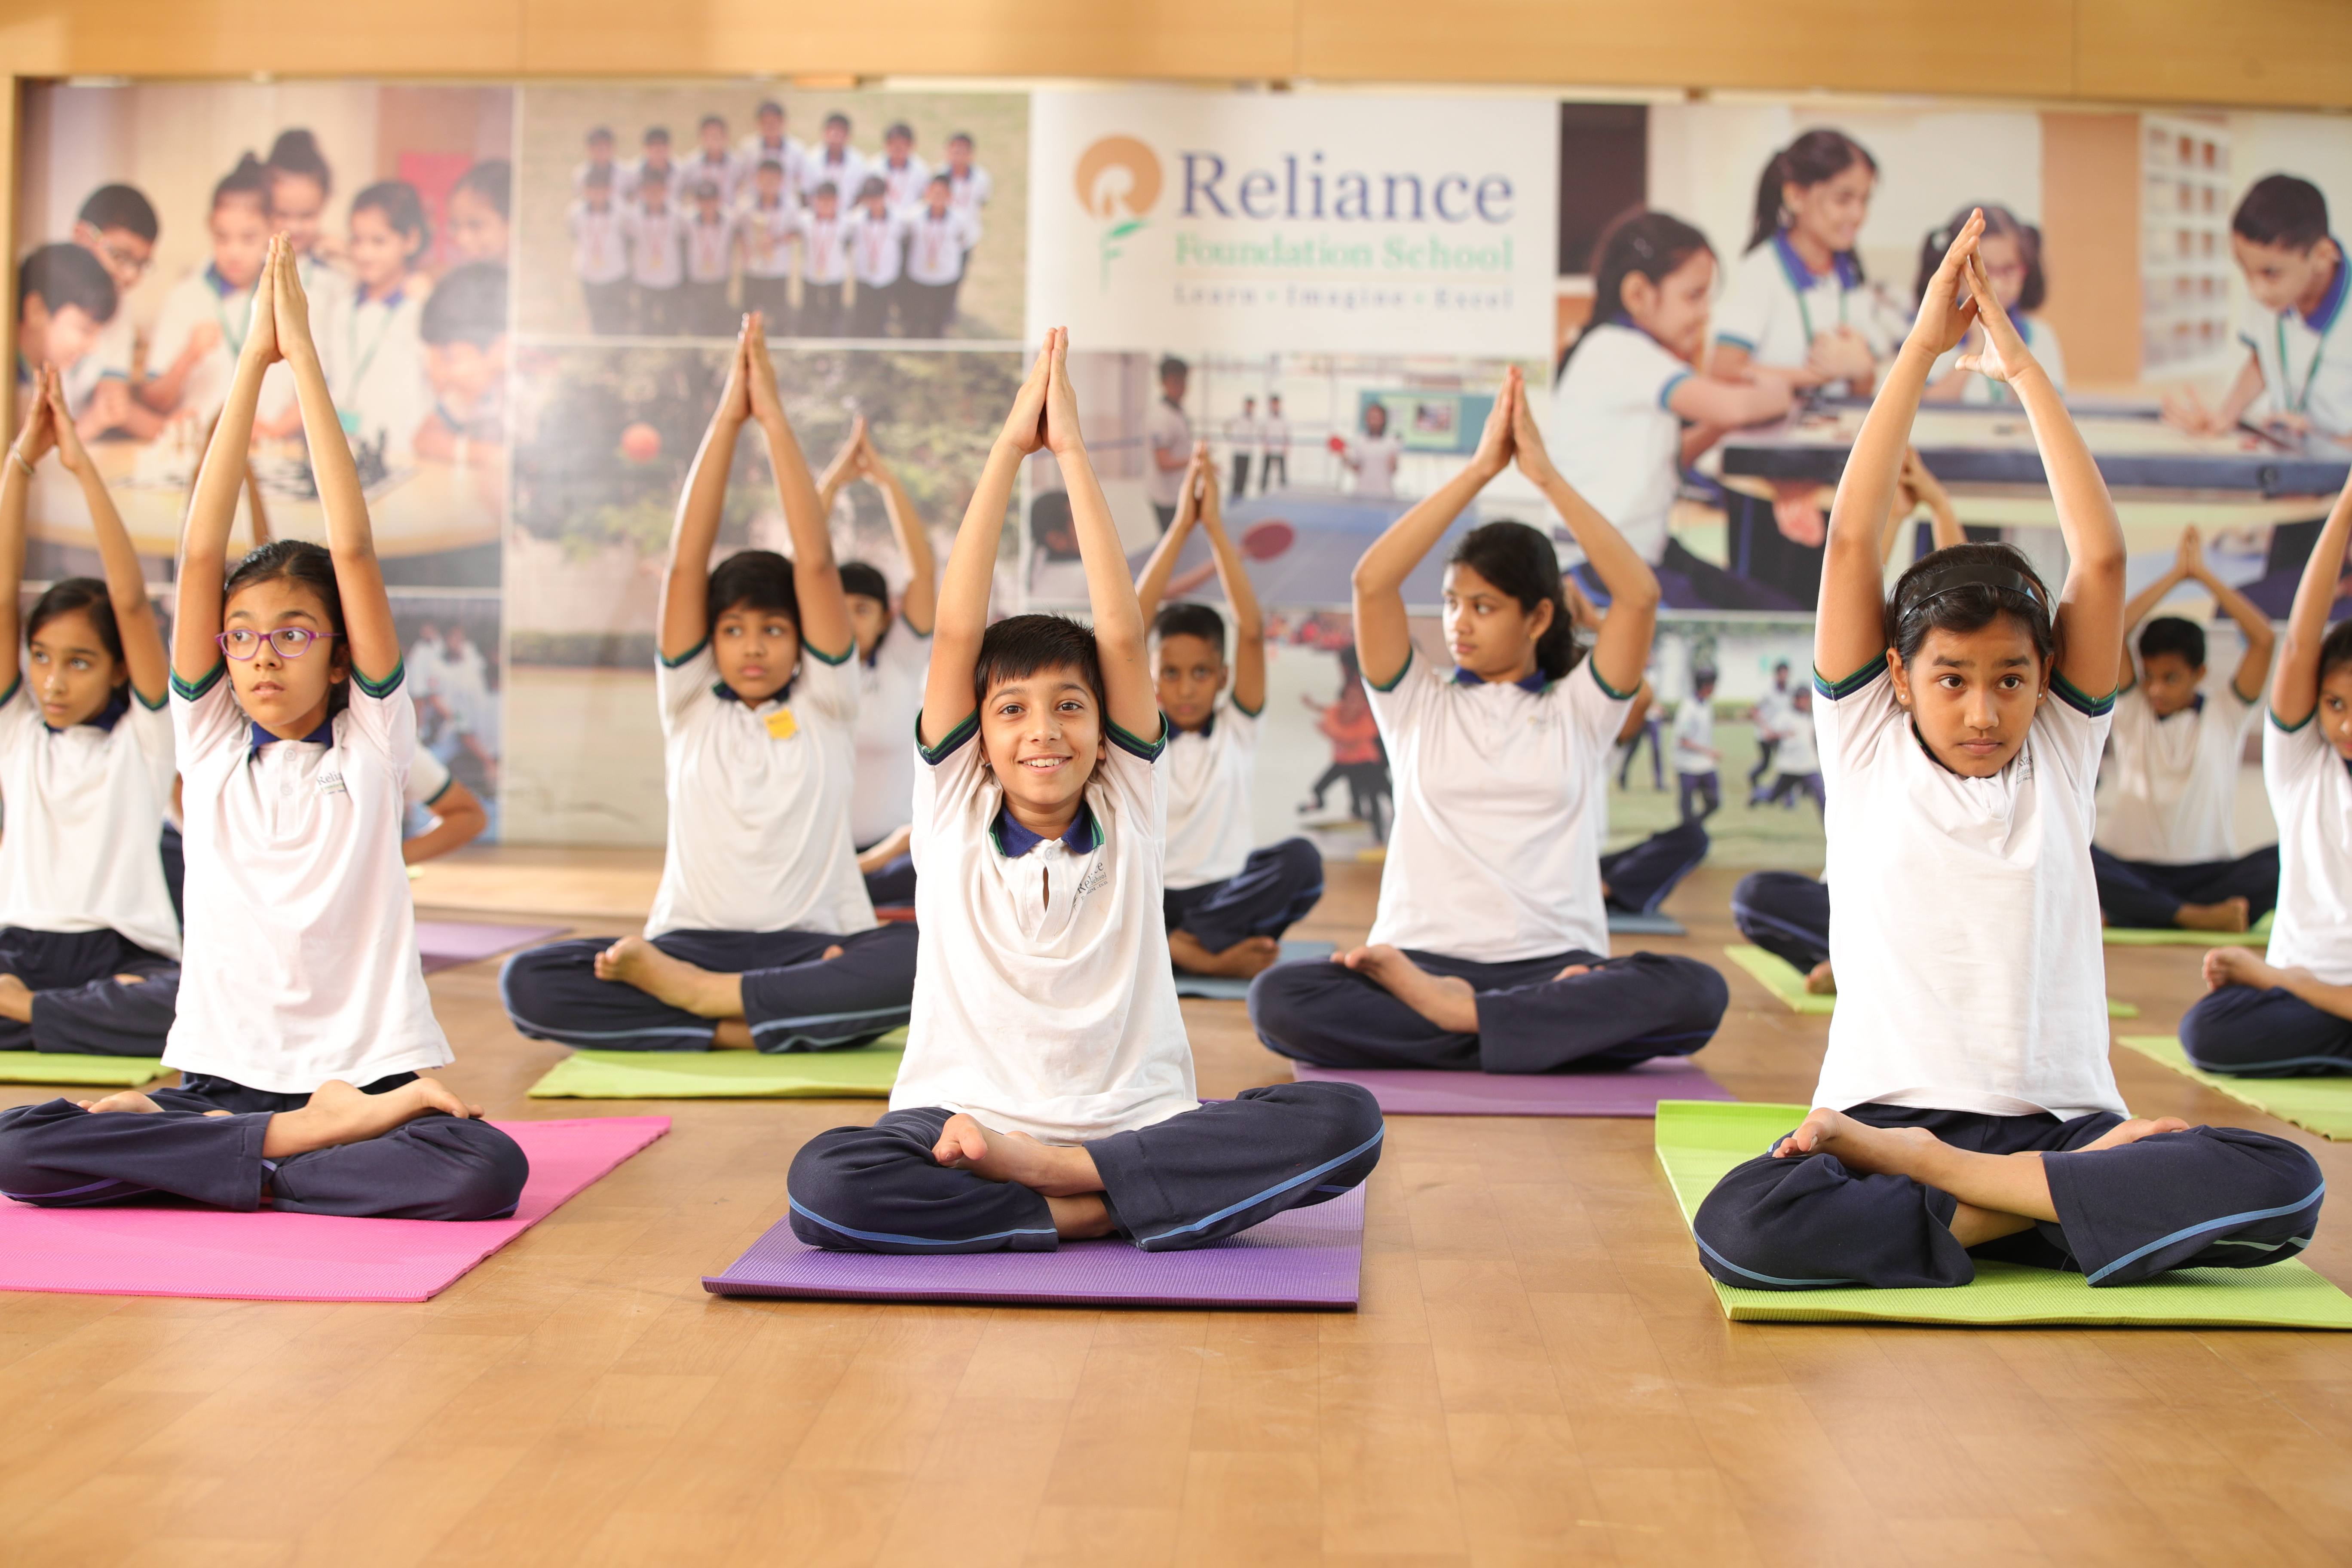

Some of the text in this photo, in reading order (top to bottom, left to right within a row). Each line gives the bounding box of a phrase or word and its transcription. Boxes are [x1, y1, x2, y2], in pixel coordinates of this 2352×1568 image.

[1176, 149, 1516, 224] Reliance
[1174, 232, 1514, 272] Foundation School
[1090, 872, 1106, 885] School
